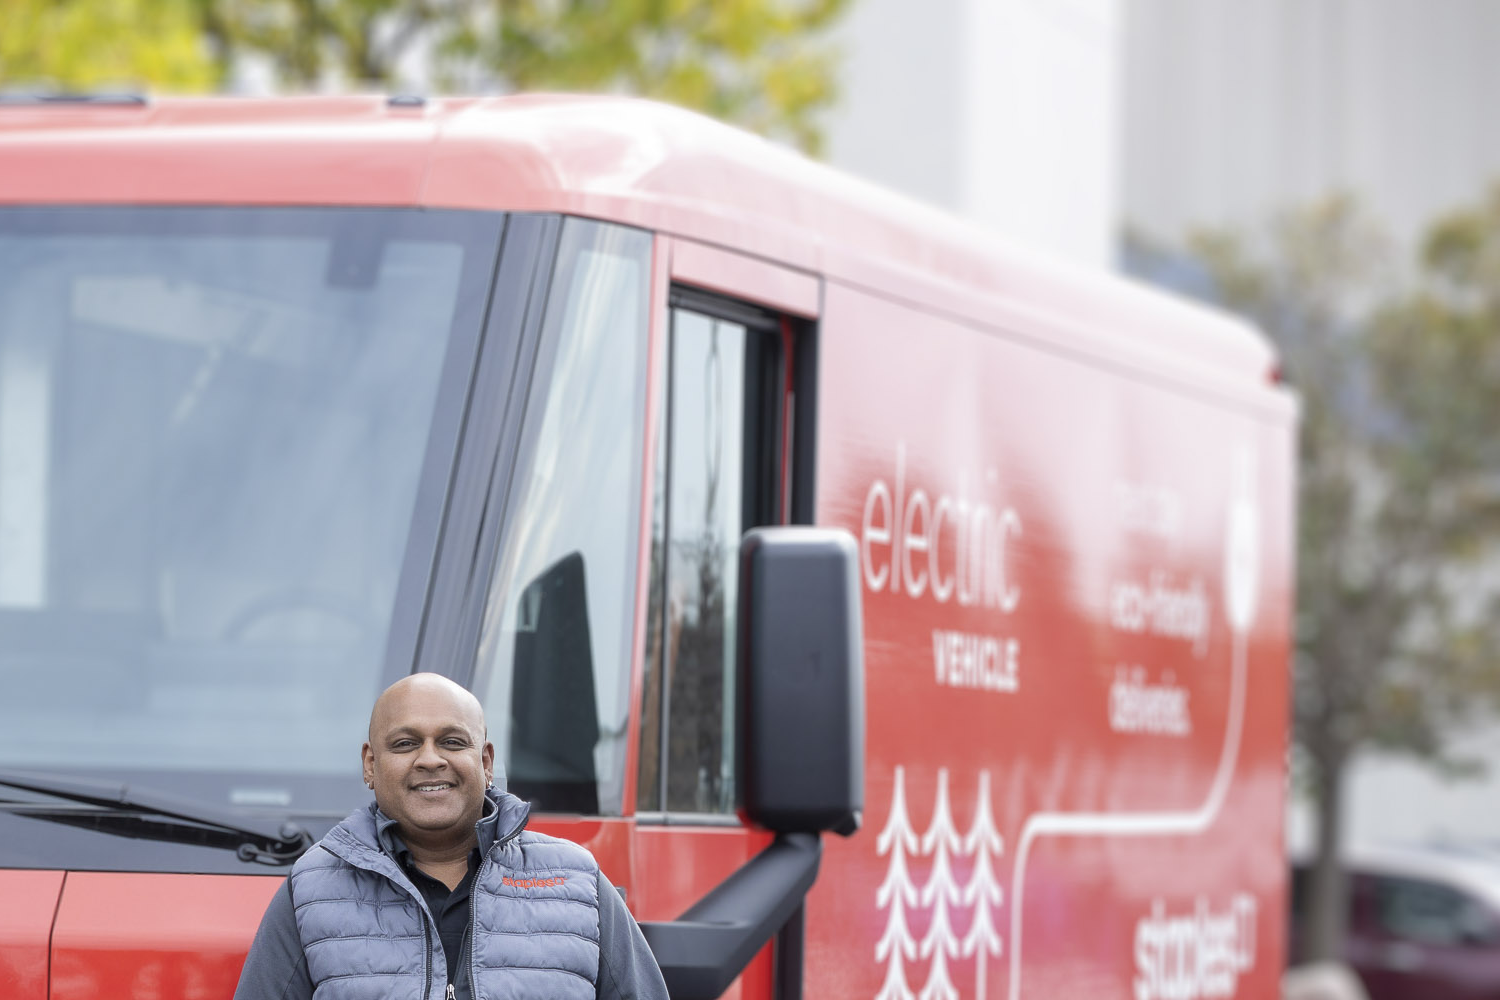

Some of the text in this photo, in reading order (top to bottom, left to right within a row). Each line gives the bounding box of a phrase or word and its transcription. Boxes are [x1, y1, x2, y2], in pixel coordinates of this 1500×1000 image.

[862, 439, 1023, 613] electric
[931, 628, 1020, 692] VEHICLE
[502, 876, 555, 890] staples
